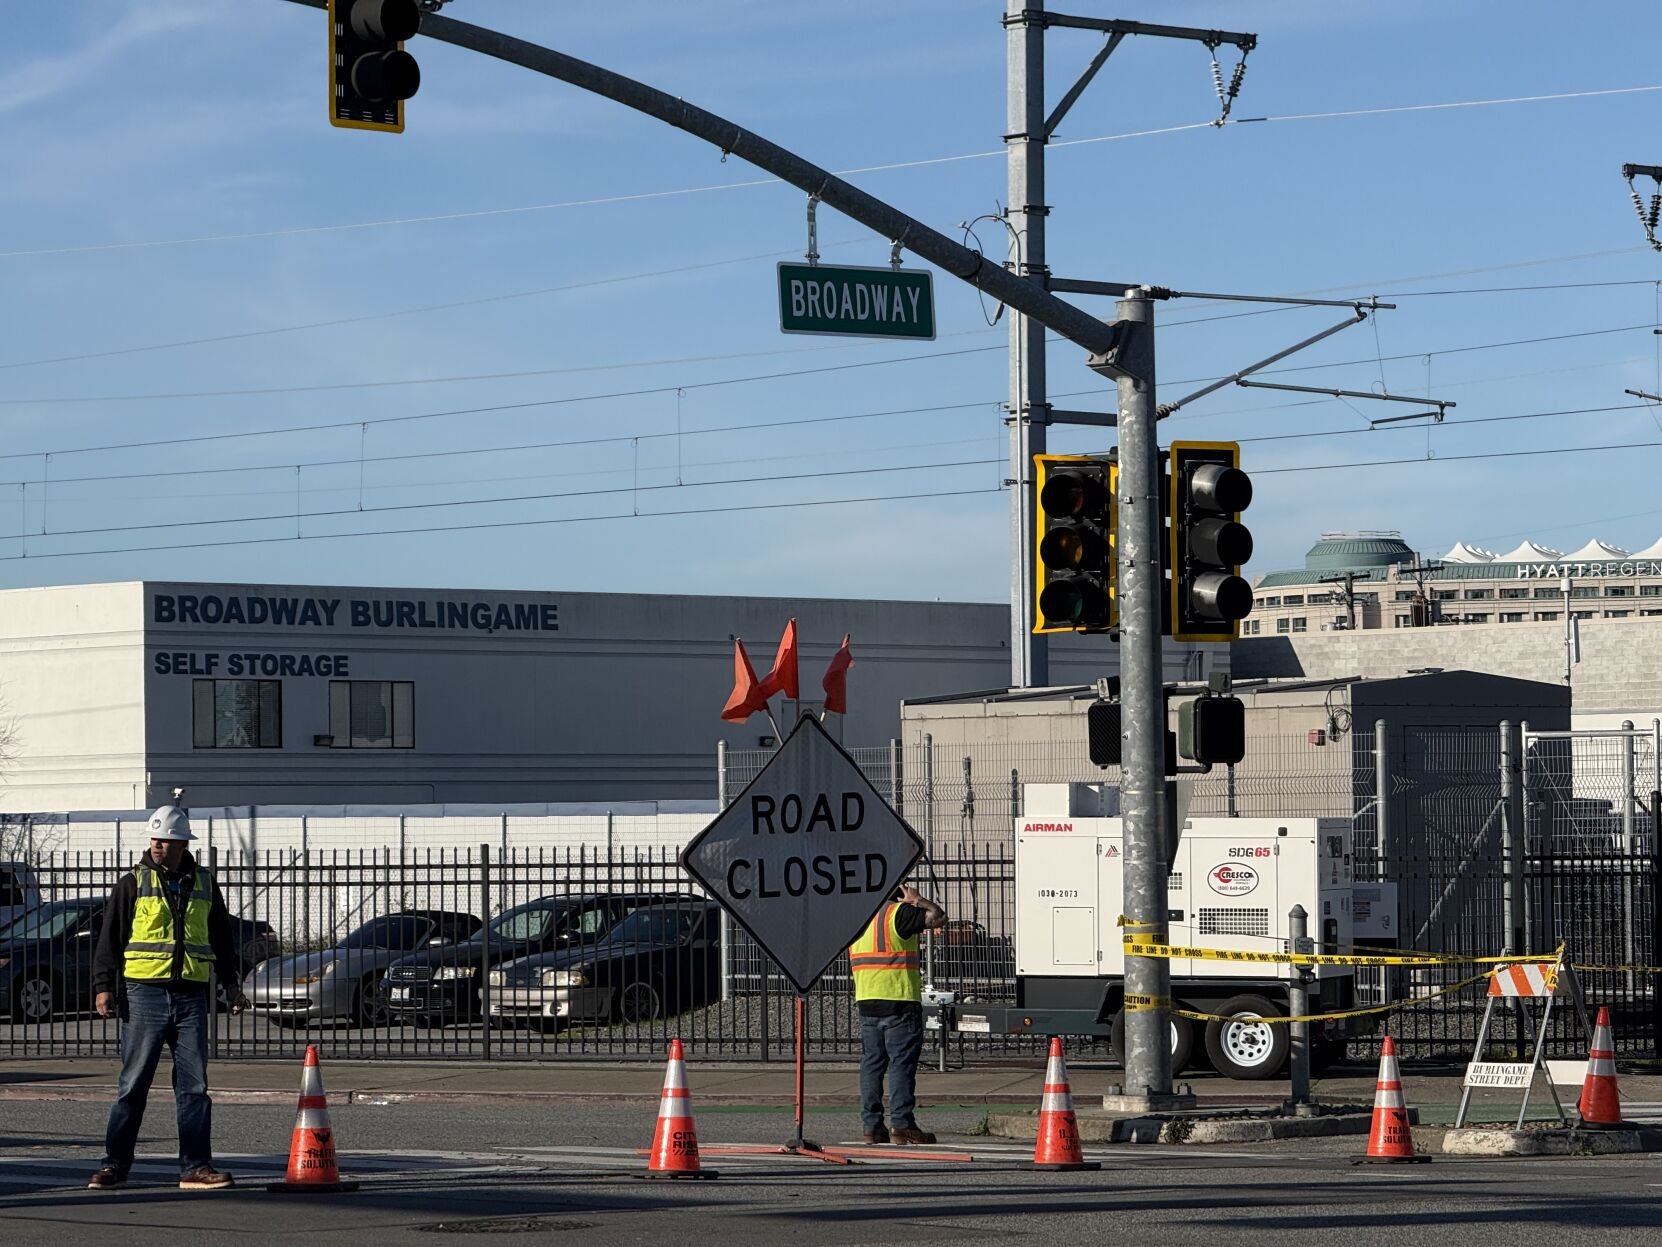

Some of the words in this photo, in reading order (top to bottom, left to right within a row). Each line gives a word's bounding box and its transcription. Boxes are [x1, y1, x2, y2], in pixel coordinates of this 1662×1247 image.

[790, 279, 921, 324] BROADWAY
[1517, 563, 1587, 578] HYATT
[153, 594, 341, 627] BROADWAY
[351, 599, 559, 632] BURLINGAME
[154, 652, 219, 676] SELF
[227, 653, 349, 677] STORAGE
[751, 791, 865, 836] ROAD
[1023, 823, 1073, 832] AIRMAN
[726, 853, 888, 900] CLOSED
[1132, 945, 1143, 953] FIRE
[1146, 946, 1157, 955] LINE
[1160, 947, 1168, 955] DO
[1171, 948, 1182, 956] NOT
[1184, 948, 1203, 957] CROSS
[1468, 1075, 1502, 1084] STREET
[1472, 1064, 1529, 1075] BURLINGAME
